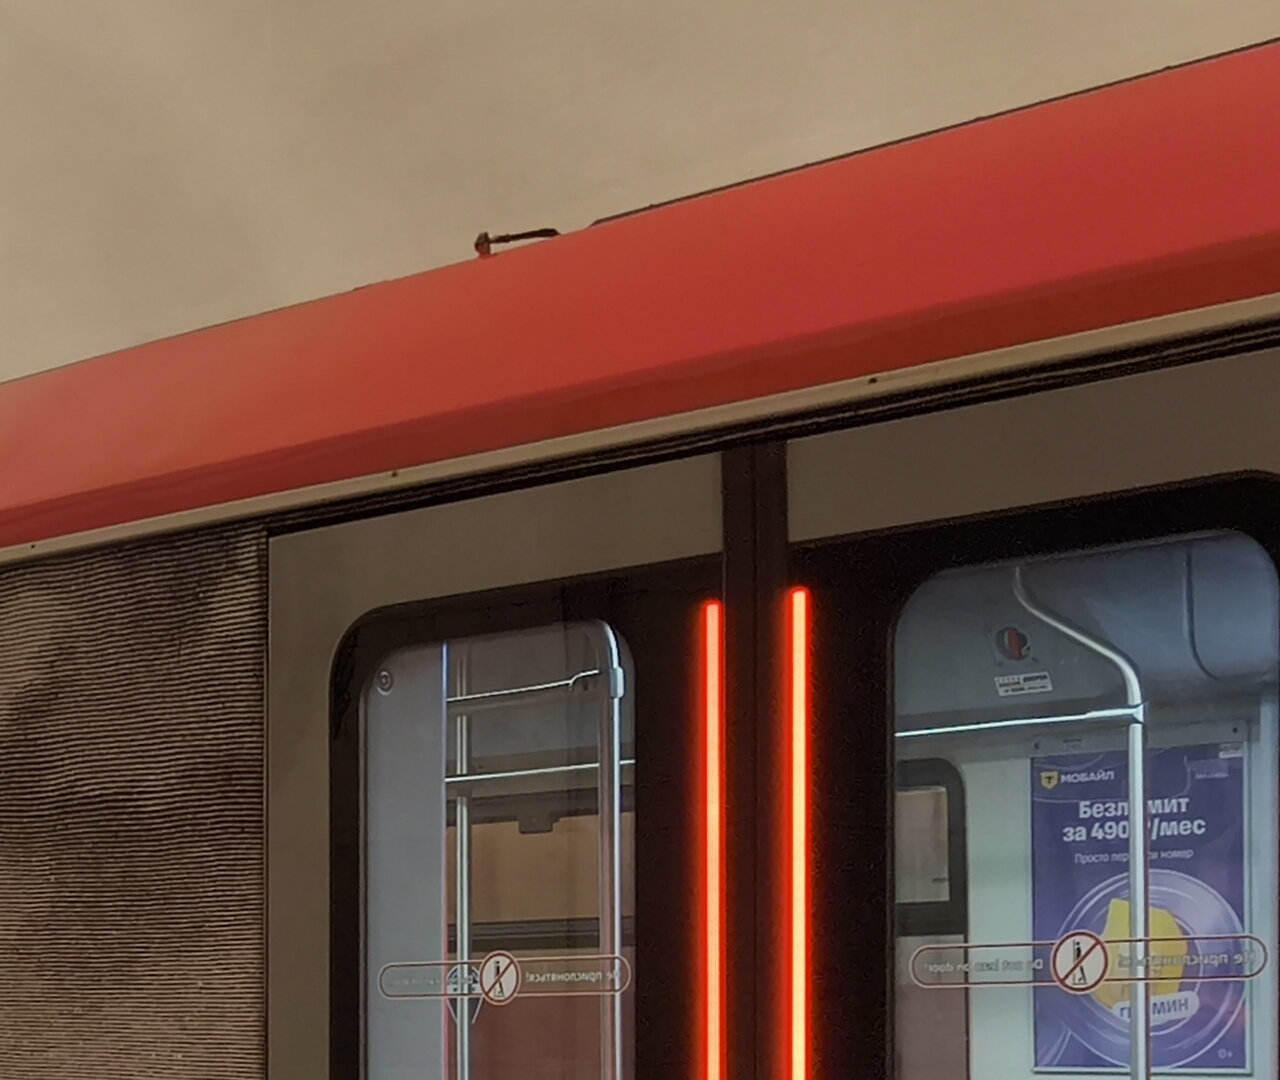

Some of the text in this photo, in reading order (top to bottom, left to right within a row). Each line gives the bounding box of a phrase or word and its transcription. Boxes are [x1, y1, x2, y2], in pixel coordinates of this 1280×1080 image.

[1060, 770, 1115, 784] МОБАЙЛ
[1079, 798, 1189, 819] Безлмит
[1062, 826, 1087, 842] за
[1090, 822, 1129, 840] 490
[1074, 852, 1109, 866] Просто
